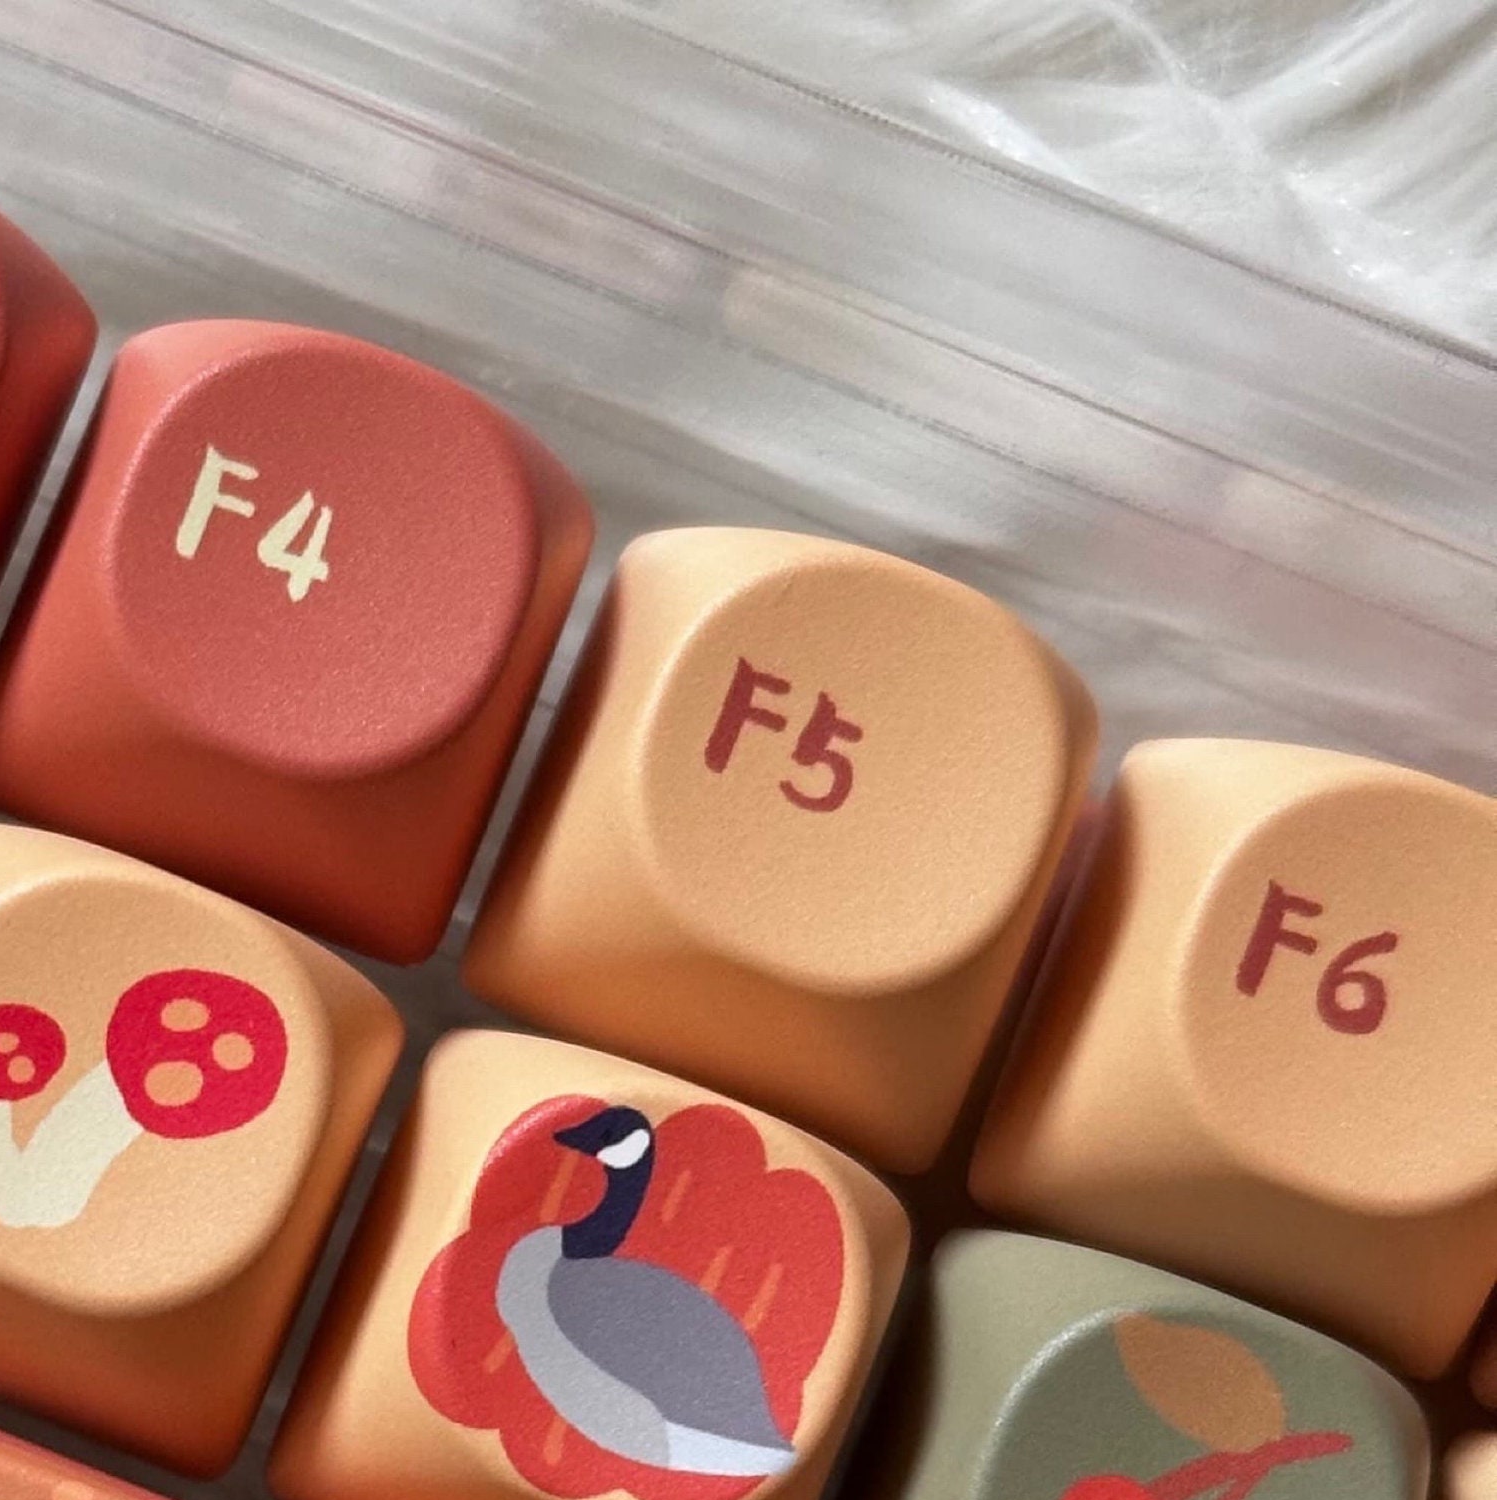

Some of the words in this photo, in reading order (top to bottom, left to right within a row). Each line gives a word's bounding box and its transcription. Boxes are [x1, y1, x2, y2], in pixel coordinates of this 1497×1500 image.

[175, 446, 334, 602] F4
[703, 656, 864, 813] F5
[1235, 879, 1399, 1036] F6
